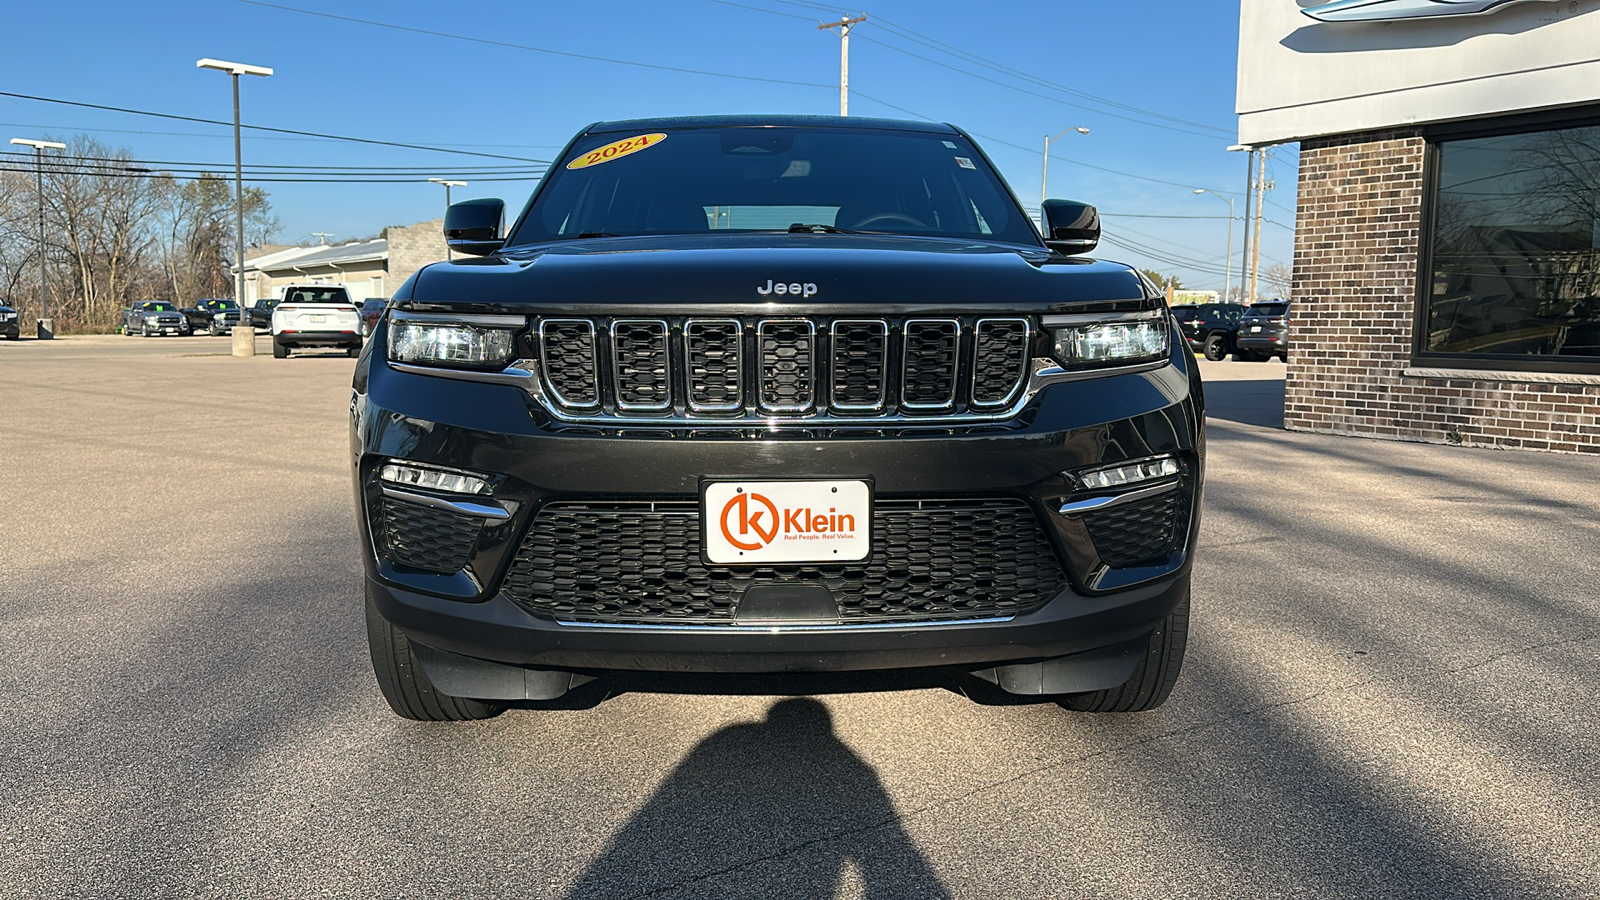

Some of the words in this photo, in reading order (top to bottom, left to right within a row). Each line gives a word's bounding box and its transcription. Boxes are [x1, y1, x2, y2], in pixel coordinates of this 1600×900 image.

[587, 136, 651, 165] 2024
[758, 279, 818, 298] Jeep
[784, 507, 855, 533] Klein
